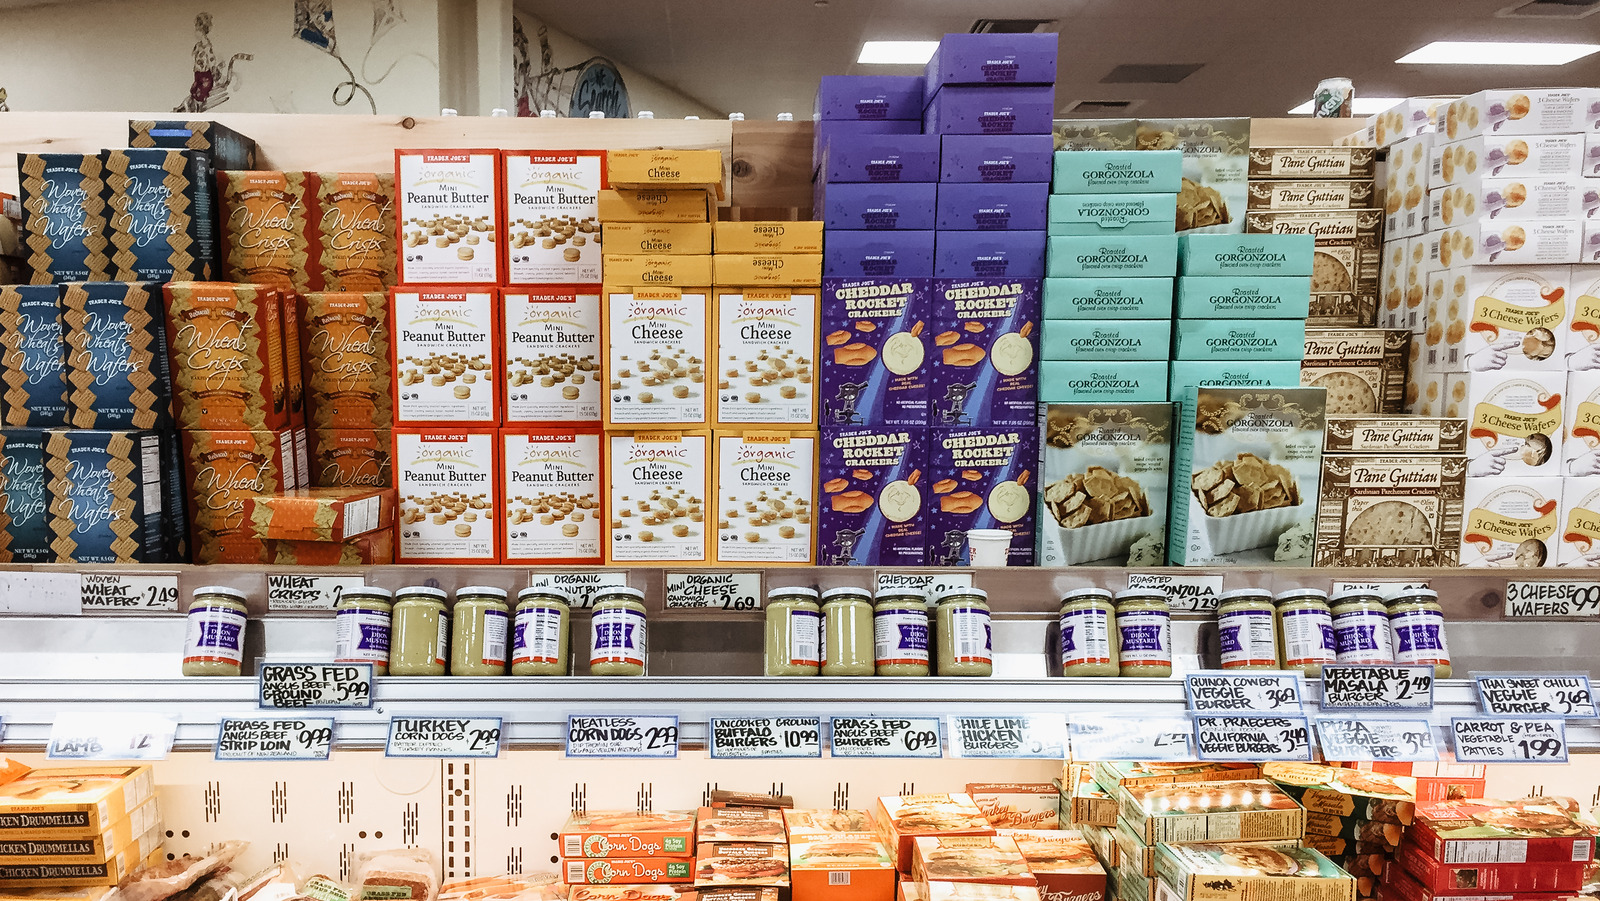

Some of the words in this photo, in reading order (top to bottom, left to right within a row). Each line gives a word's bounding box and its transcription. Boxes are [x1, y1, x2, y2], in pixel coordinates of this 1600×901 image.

[1280, 156, 1306, 168] Pane
[424, 168, 477, 182] organic
[648, 168, 681, 178] Cheese
[1082, 170, 1154, 179] GORGONZOLA
[41, 176, 88, 200] Woven
[407, 192, 449, 204] Peanut
[452, 192, 489, 204] Butter
[231, 201, 301, 230] Wheat
[35, 214, 97, 249] Wafers
[239, 228, 295, 267] Crisps
[1215, 254, 1287, 263] GORGONZOLA
[836, 283, 914, 300] CHEDDAR
[845, 297, 908, 310] ROCKET
[1072, 296, 1144, 306] GORGONZOLA
[634, 304, 688, 320] organic
[848, 309, 902, 318] CRACKERS
[1480, 307, 1488, 318] 3
[1488, 309, 1524, 325] Cheese
[1526, 313, 1560, 327] Wafers
[85, 310, 133, 334] Woven
[178, 320, 256, 352] Wheat
[403, 331, 445, 343] Peanut
[448, 331, 486, 343] Butter
[632, 325, 684, 340] Cheese
[1304, 340, 1333, 355] Pane
[1337, 340, 1382, 359] Guttiau
[77, 351, 143, 386] Wafers
[187, 352, 249, 391] Crisps
[1227, 418, 1294, 428] GORGONZOLA
[943, 433, 1020, 449] CHEDDAR
[952, 447, 1014, 460] ROCKET
[954, 459, 1009, 468] CRACKERS
[741, 467, 791, 482] Cheese
[1354, 468, 1387, 483] Pane
[1389, 468, 1438, 487] Guttiau
[1474, 519, 1483, 529] 3
[1483, 521, 1517, 537] Cheese
[1519, 525, 1552, 538] Wafers
[85, 575, 121, 585] WOVEN
[269, 576, 319, 588] WHEAT
[554, 575, 601, 584] ORGANIC
[686, 575, 734, 584] ORGANIC
[879, 575, 934, 585] CHEDDAR
[1130, 576, 1172, 584] ROASTED
[81, 585, 131, 597] WHEAT
[269, 588, 321, 600] CRISPS
[667, 581, 686, 593] MINI
[684, 585, 739, 596] CHEESE
[1507, 583, 1518, 602] 3
[1521, 584, 1577, 600] CHEESE
[81, 595, 140, 607] WAFERS
[667, 595, 706, 603] SANDWICH
[1512, 601, 1570, 617] WAFERS
[263, 666, 317, 682] GRASS
[322, 667, 359, 681] FED
[1324, 668, 1410, 680] VEGETABLE
[263, 681, 300, 690] ANGUS
[302, 681, 332, 689] BEEF
[1190, 678, 1228, 688] QUINOA
[1233, 678, 1280, 687] COWBOY
[1324, 679, 1389, 693] MASALA
[1480, 679, 1504, 689] THAI
[1505, 680, 1540, 689] SWEET
[263, 689, 322, 700] GROUND
[1190, 688, 1245, 700] VEGGIE
[1328, 692, 1391, 703] BURGER
[1482, 690, 1537, 701] VEGGIE
[274, 699, 315, 708] BEEF
[1195, 700, 1255, 710] BURGER
[1492, 701, 1557, 714] BURGER
[224, 720, 270, 731] GRASS
[273, 720, 306, 731] FED
[392, 720, 471, 733] TURKEY
[572, 718, 636, 728] MEATLESS
[714, 719, 770, 728] UNCOOKED
[776, 718, 819, 727] GROUND
[834, 719, 878, 729] GRASS
[882, 720, 911, 729] FED
[1199, 718, 1222, 728] DR.
[1224, 718, 1292, 728] PRAEGERS
[1455, 722, 1505, 733] CARROT
[1511, 722, 1523, 733] &
[1527, 722, 1554, 733] PEA
[222, 731, 259, 741] ANGUS
[260, 731, 288, 740] BEEF
[395, 732, 429, 741] CORN
[432, 732, 465, 741] DOGS
[570, 728, 608, 742] CORN
[611, 728, 643, 741] DOGS
[714, 727, 771, 738] BUFFALO
[834, 729, 867, 738] ANGUS
[870, 729, 899, 737] BEEF
[1200, 732, 1270, 743] CALIFORNIA
[715, 737, 777, 748] BURGERS
[834, 738, 891, 747] BURGERS
[1458, 734, 1514, 744] VEGETABLE
[220, 740, 257, 751] STRIP
[261, 740, 291, 750] LOIN
[964, 741, 1019, 750] BURGERS
[1199, 743, 1234, 753] VEGGIE
[1235, 743, 1283, 754] BURGERS
[1462, 745, 1504, 756] PATTIES
[629, 837, 662, 855] Dogs
